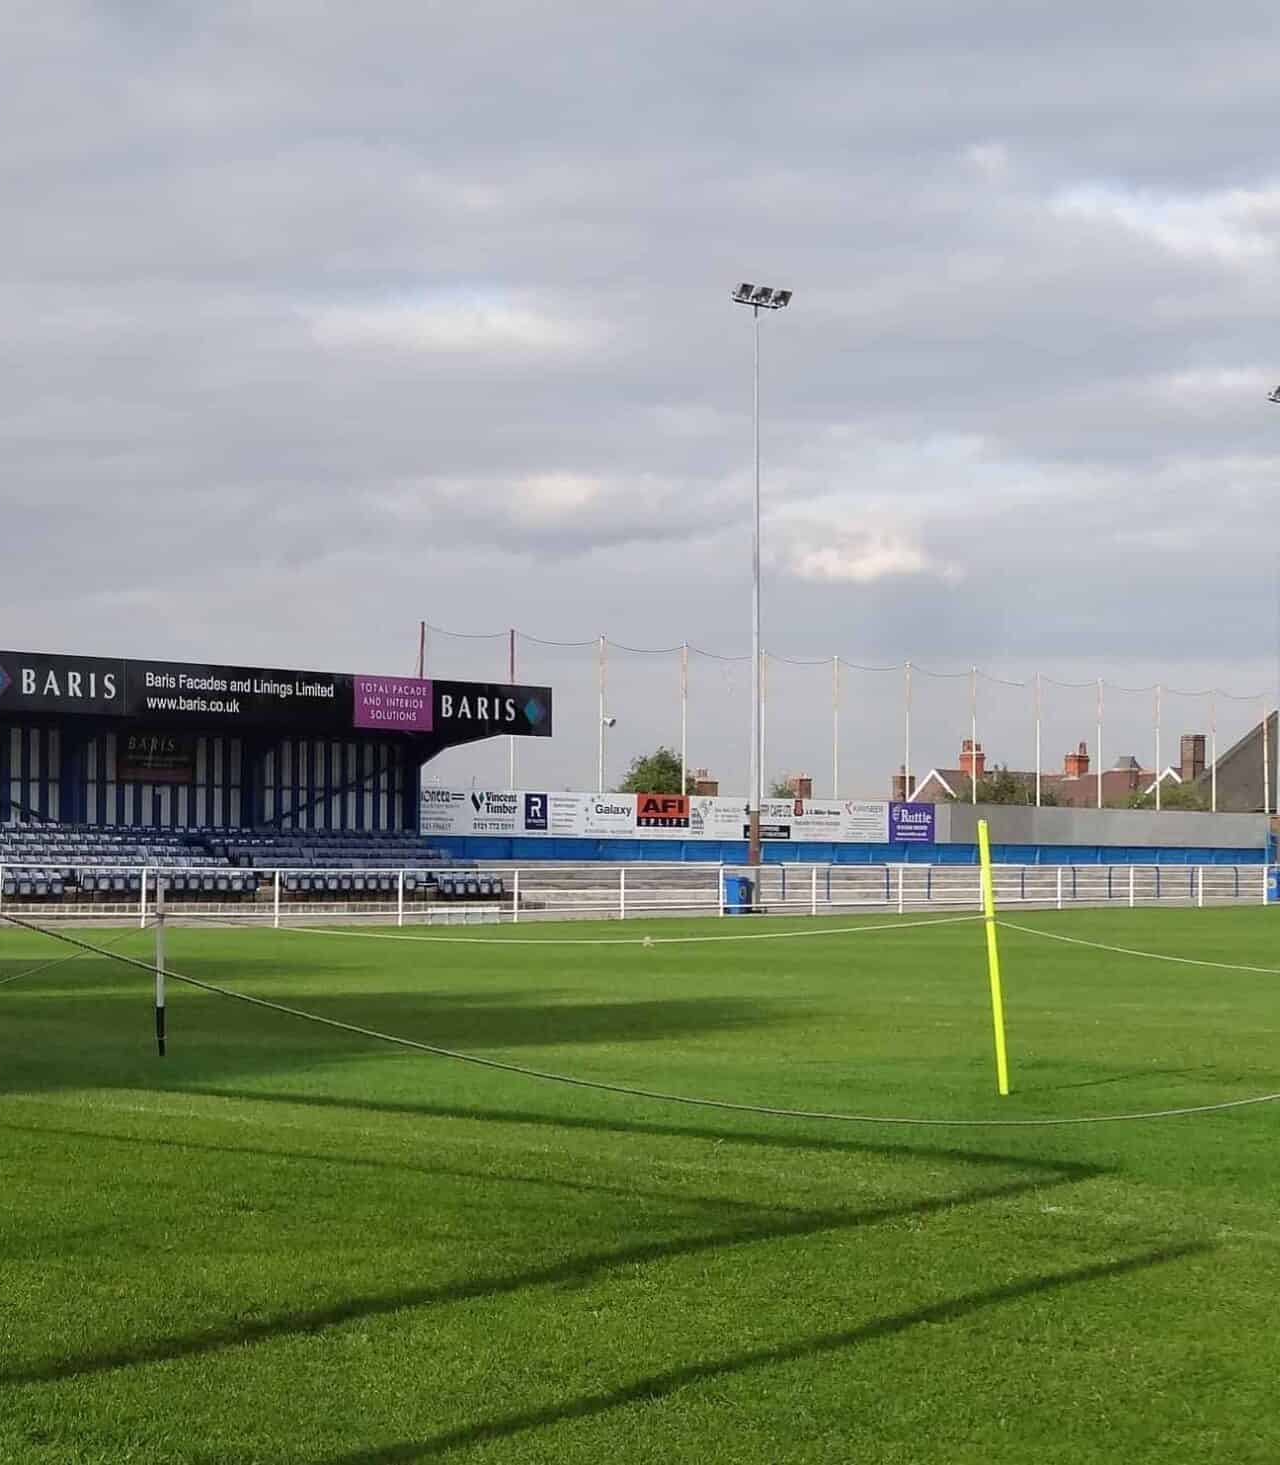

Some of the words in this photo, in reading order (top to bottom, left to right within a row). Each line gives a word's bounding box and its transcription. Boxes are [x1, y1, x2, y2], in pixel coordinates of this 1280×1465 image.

[21, 667, 117, 700] BARIS
[145, 671, 176, 689] Baris
[178, 674, 227, 692] Facades
[230, 678, 251, 693] and
[253, 679, 293, 698] Linings
[295, 681, 334, 698] Limited
[360, 682, 389, 694] TOTAL
[392, 684, 427, 696] FACADE
[146, 696, 240, 713] www.baris.co.uk
[363, 696, 382, 706] AND
[386, 698, 423, 709] INTERIOR
[441, 694, 516, 722] BARIS
[370, 709, 417, 721] SOLUTIONS
[485, 791, 518, 803] Vincent
[485, 802, 518, 814] Timber
[530, 797, 542, 818] R
[595, 803, 632, 817] Galaxy
[642, 798, 684, 813] AFI
